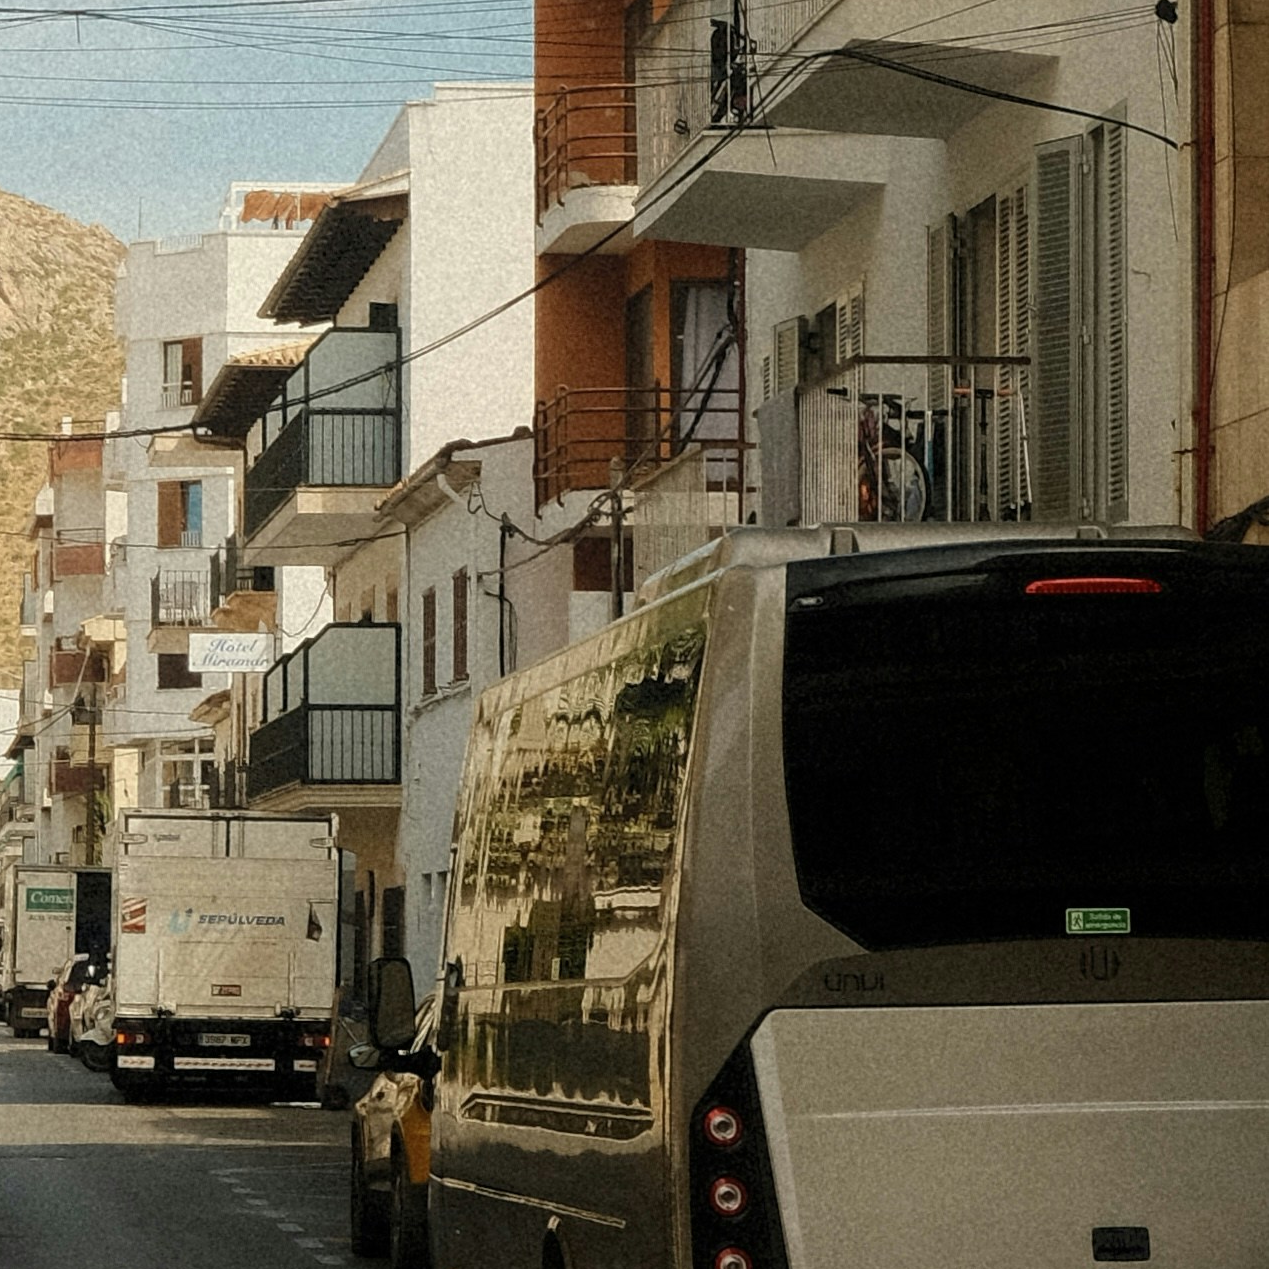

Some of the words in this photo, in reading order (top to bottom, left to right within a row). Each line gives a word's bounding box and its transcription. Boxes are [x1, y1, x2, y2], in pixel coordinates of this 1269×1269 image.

[208, 638, 259, 653] Hotel
[194, 652, 270, 667] Miramar
[197, 912, 286, 927] SEPÚLVEDA
